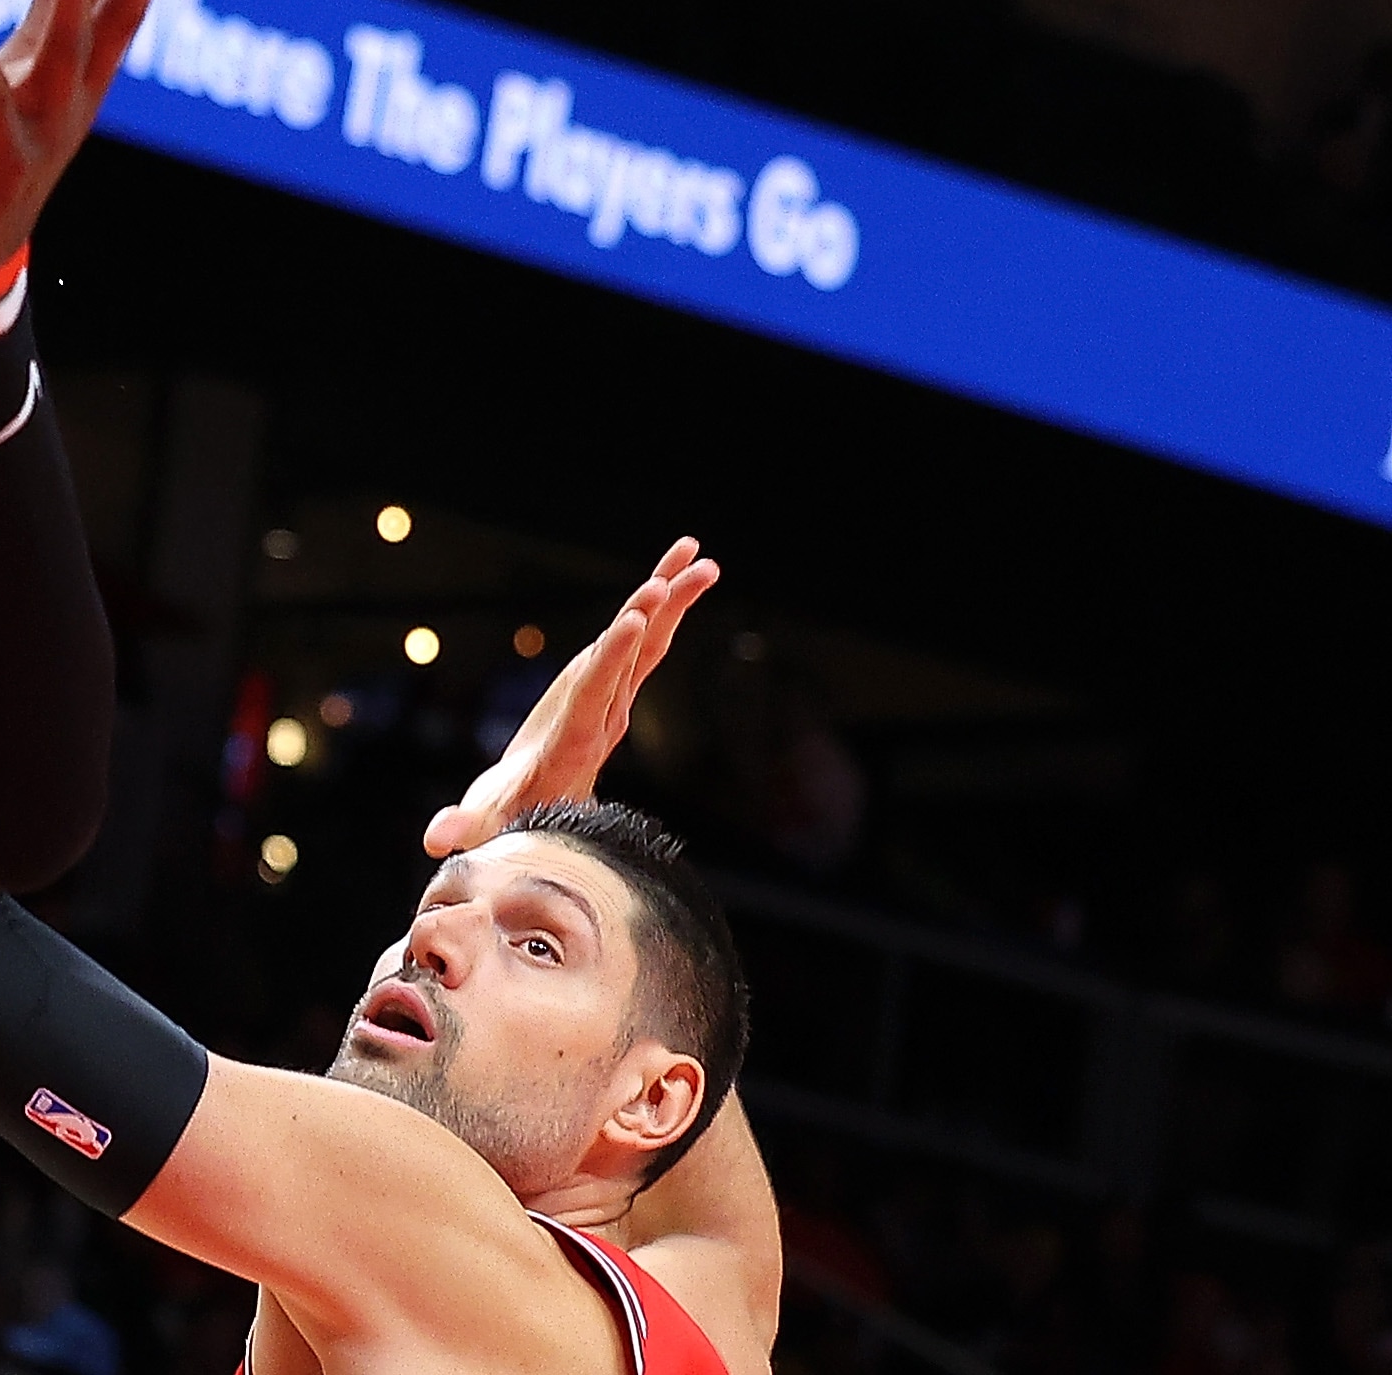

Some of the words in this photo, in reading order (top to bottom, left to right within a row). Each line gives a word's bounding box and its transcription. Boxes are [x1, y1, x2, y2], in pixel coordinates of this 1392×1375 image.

[343, 24, 479, 174] The
[481, 71, 742, 254] Players
[748, 156, 858, 291] Go
